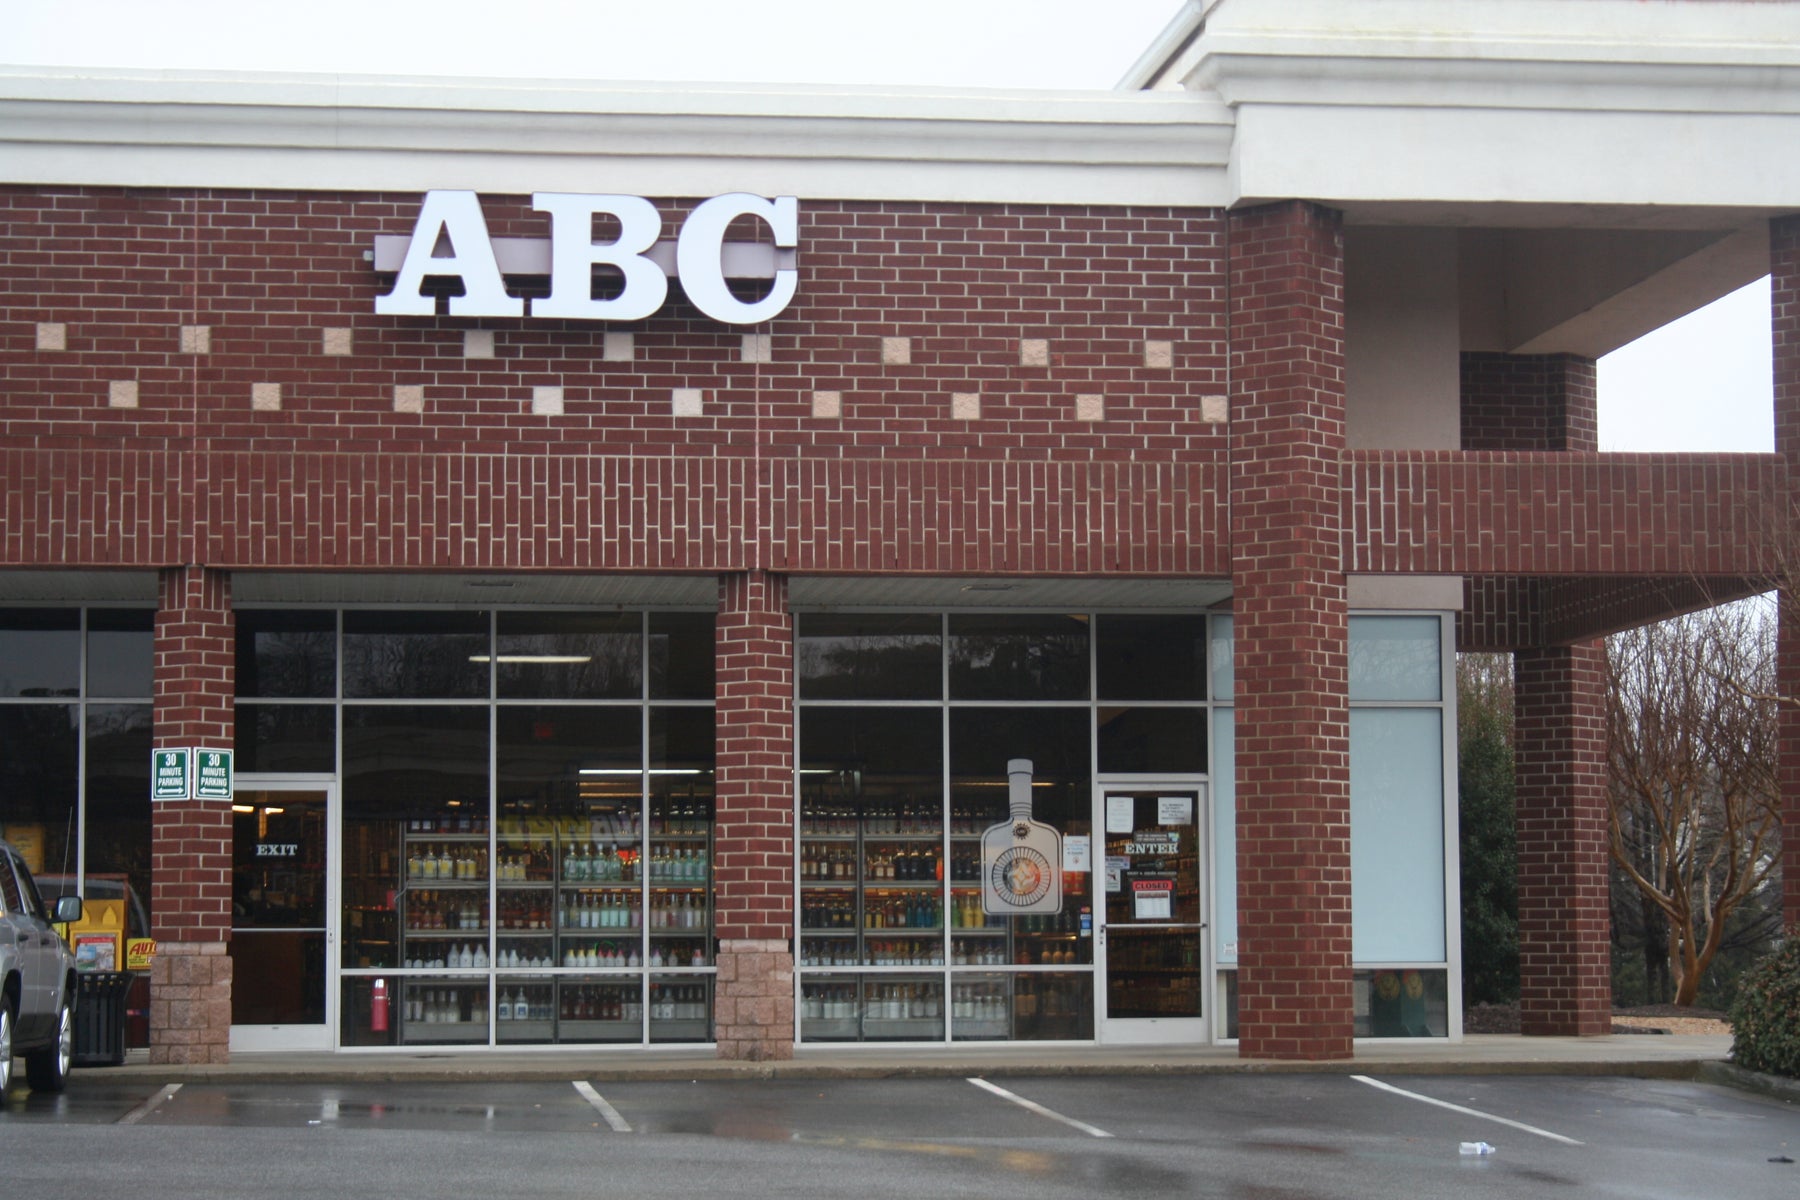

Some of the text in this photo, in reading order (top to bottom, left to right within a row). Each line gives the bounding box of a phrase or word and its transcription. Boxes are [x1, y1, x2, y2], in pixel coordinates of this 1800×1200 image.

[374, 189, 799, 325] ABC
[165, 753, 176, 766] 30
[208, 753, 220, 766] 30
[159, 767, 182, 776] MINUTE
[202, 767, 226, 777] MINUTE
[158, 777, 183, 787] PARKING
[200, 777, 227, 787] PARKING
[256, 844, 298, 856] EXIT
[1124, 843, 1178, 854] ENTER
